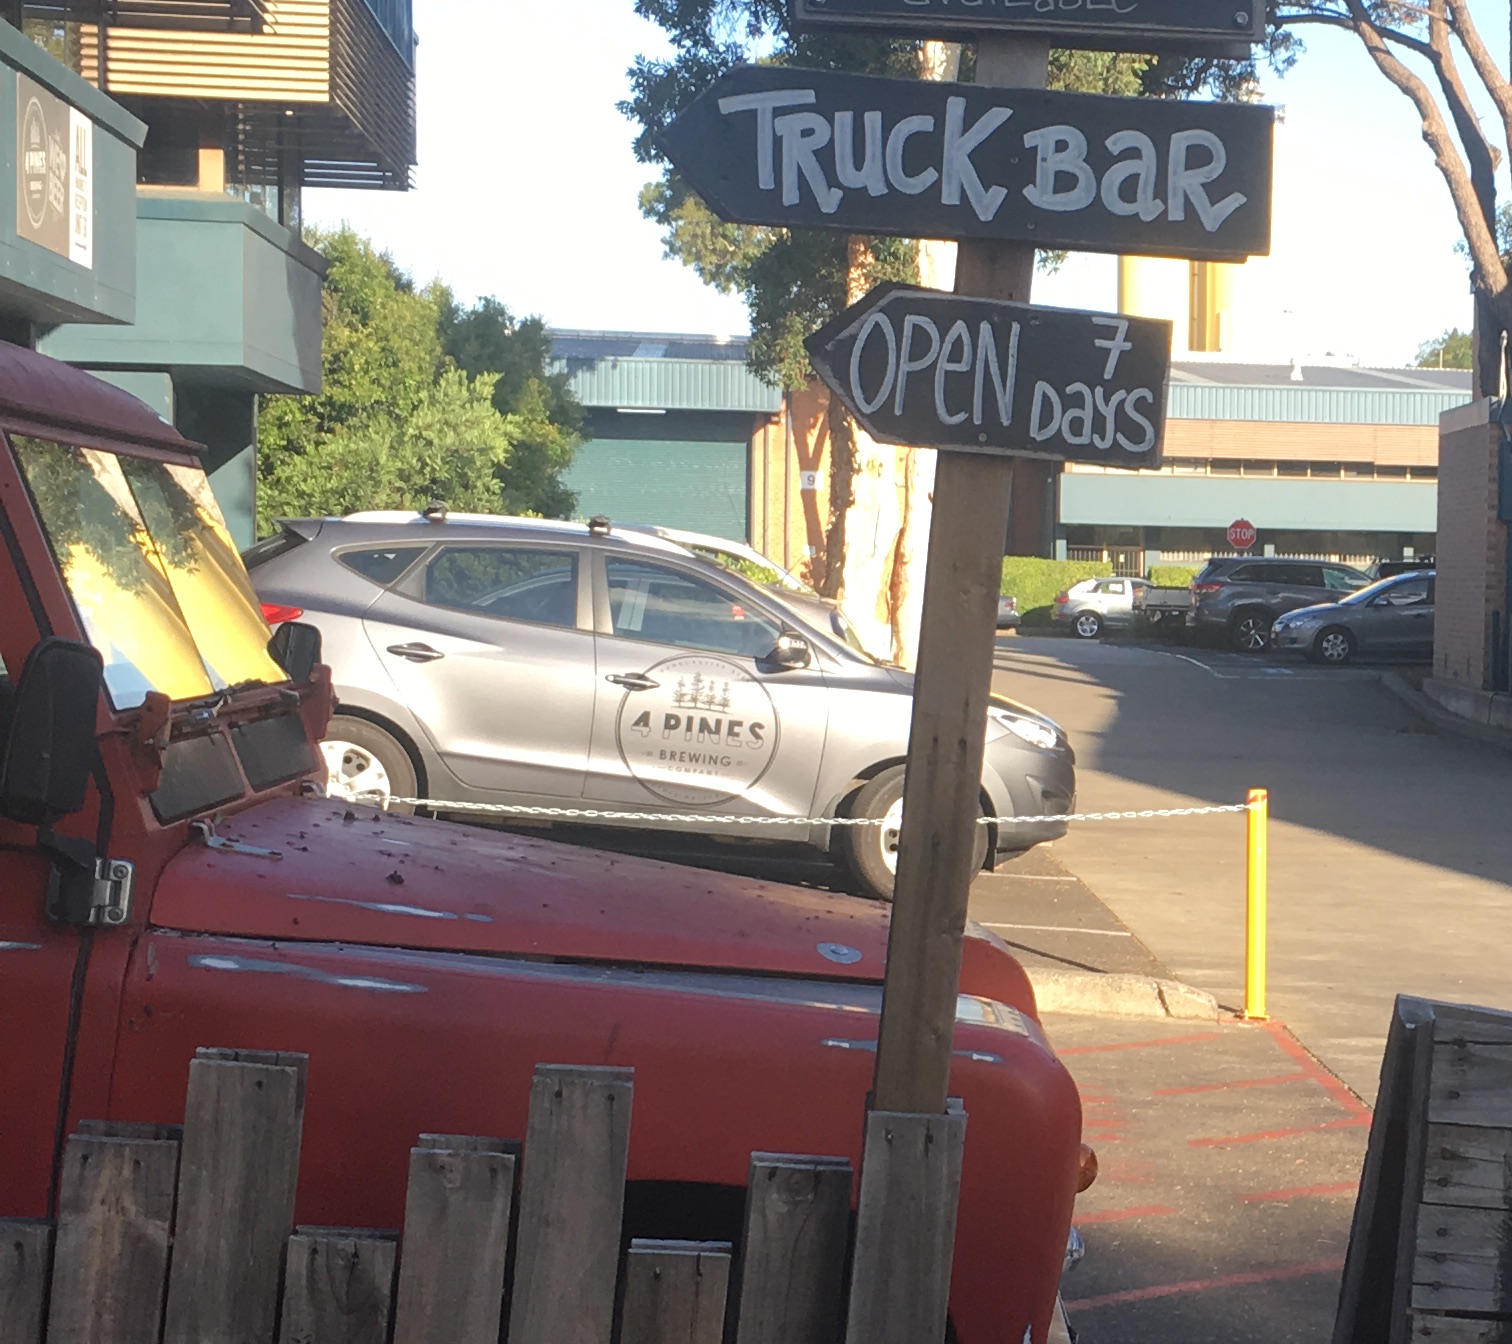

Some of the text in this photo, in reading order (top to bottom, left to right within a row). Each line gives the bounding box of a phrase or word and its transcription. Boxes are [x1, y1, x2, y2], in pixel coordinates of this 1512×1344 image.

[1091, 315, 1132, 381] 7
[807, 474, 816, 486] 9
[1229, 528, 1255, 540] STOP
[631, 710, 766, 750] 4 PINES
[659, 749, 732, 767] BREWING
[667, 765, 721, 777] COMPANY
